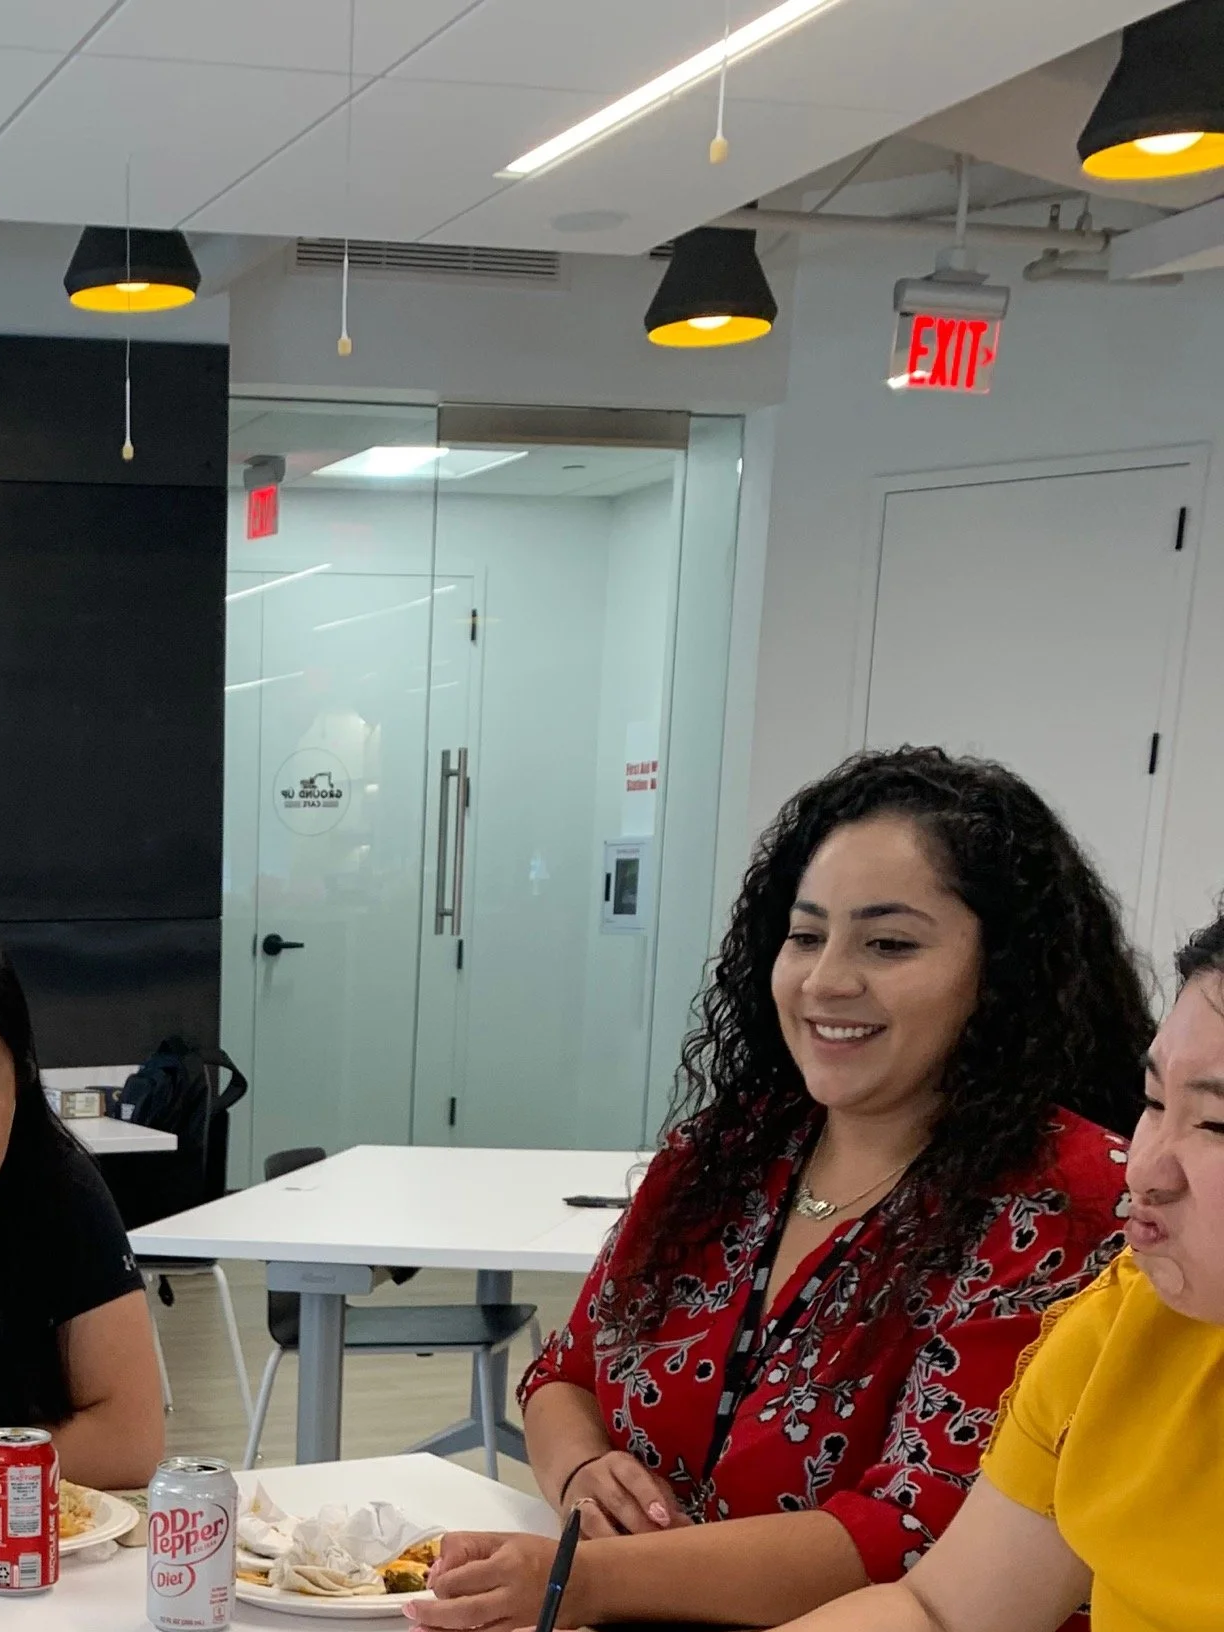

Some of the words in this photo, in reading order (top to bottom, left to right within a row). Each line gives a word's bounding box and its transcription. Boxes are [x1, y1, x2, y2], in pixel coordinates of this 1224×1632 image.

[908, 316, 988, 388] EXIT
[150, 1511, 224, 1559] Pepper
[170, 1508, 204, 1536] Dr
[157, 1572, 183, 1587] Diet
